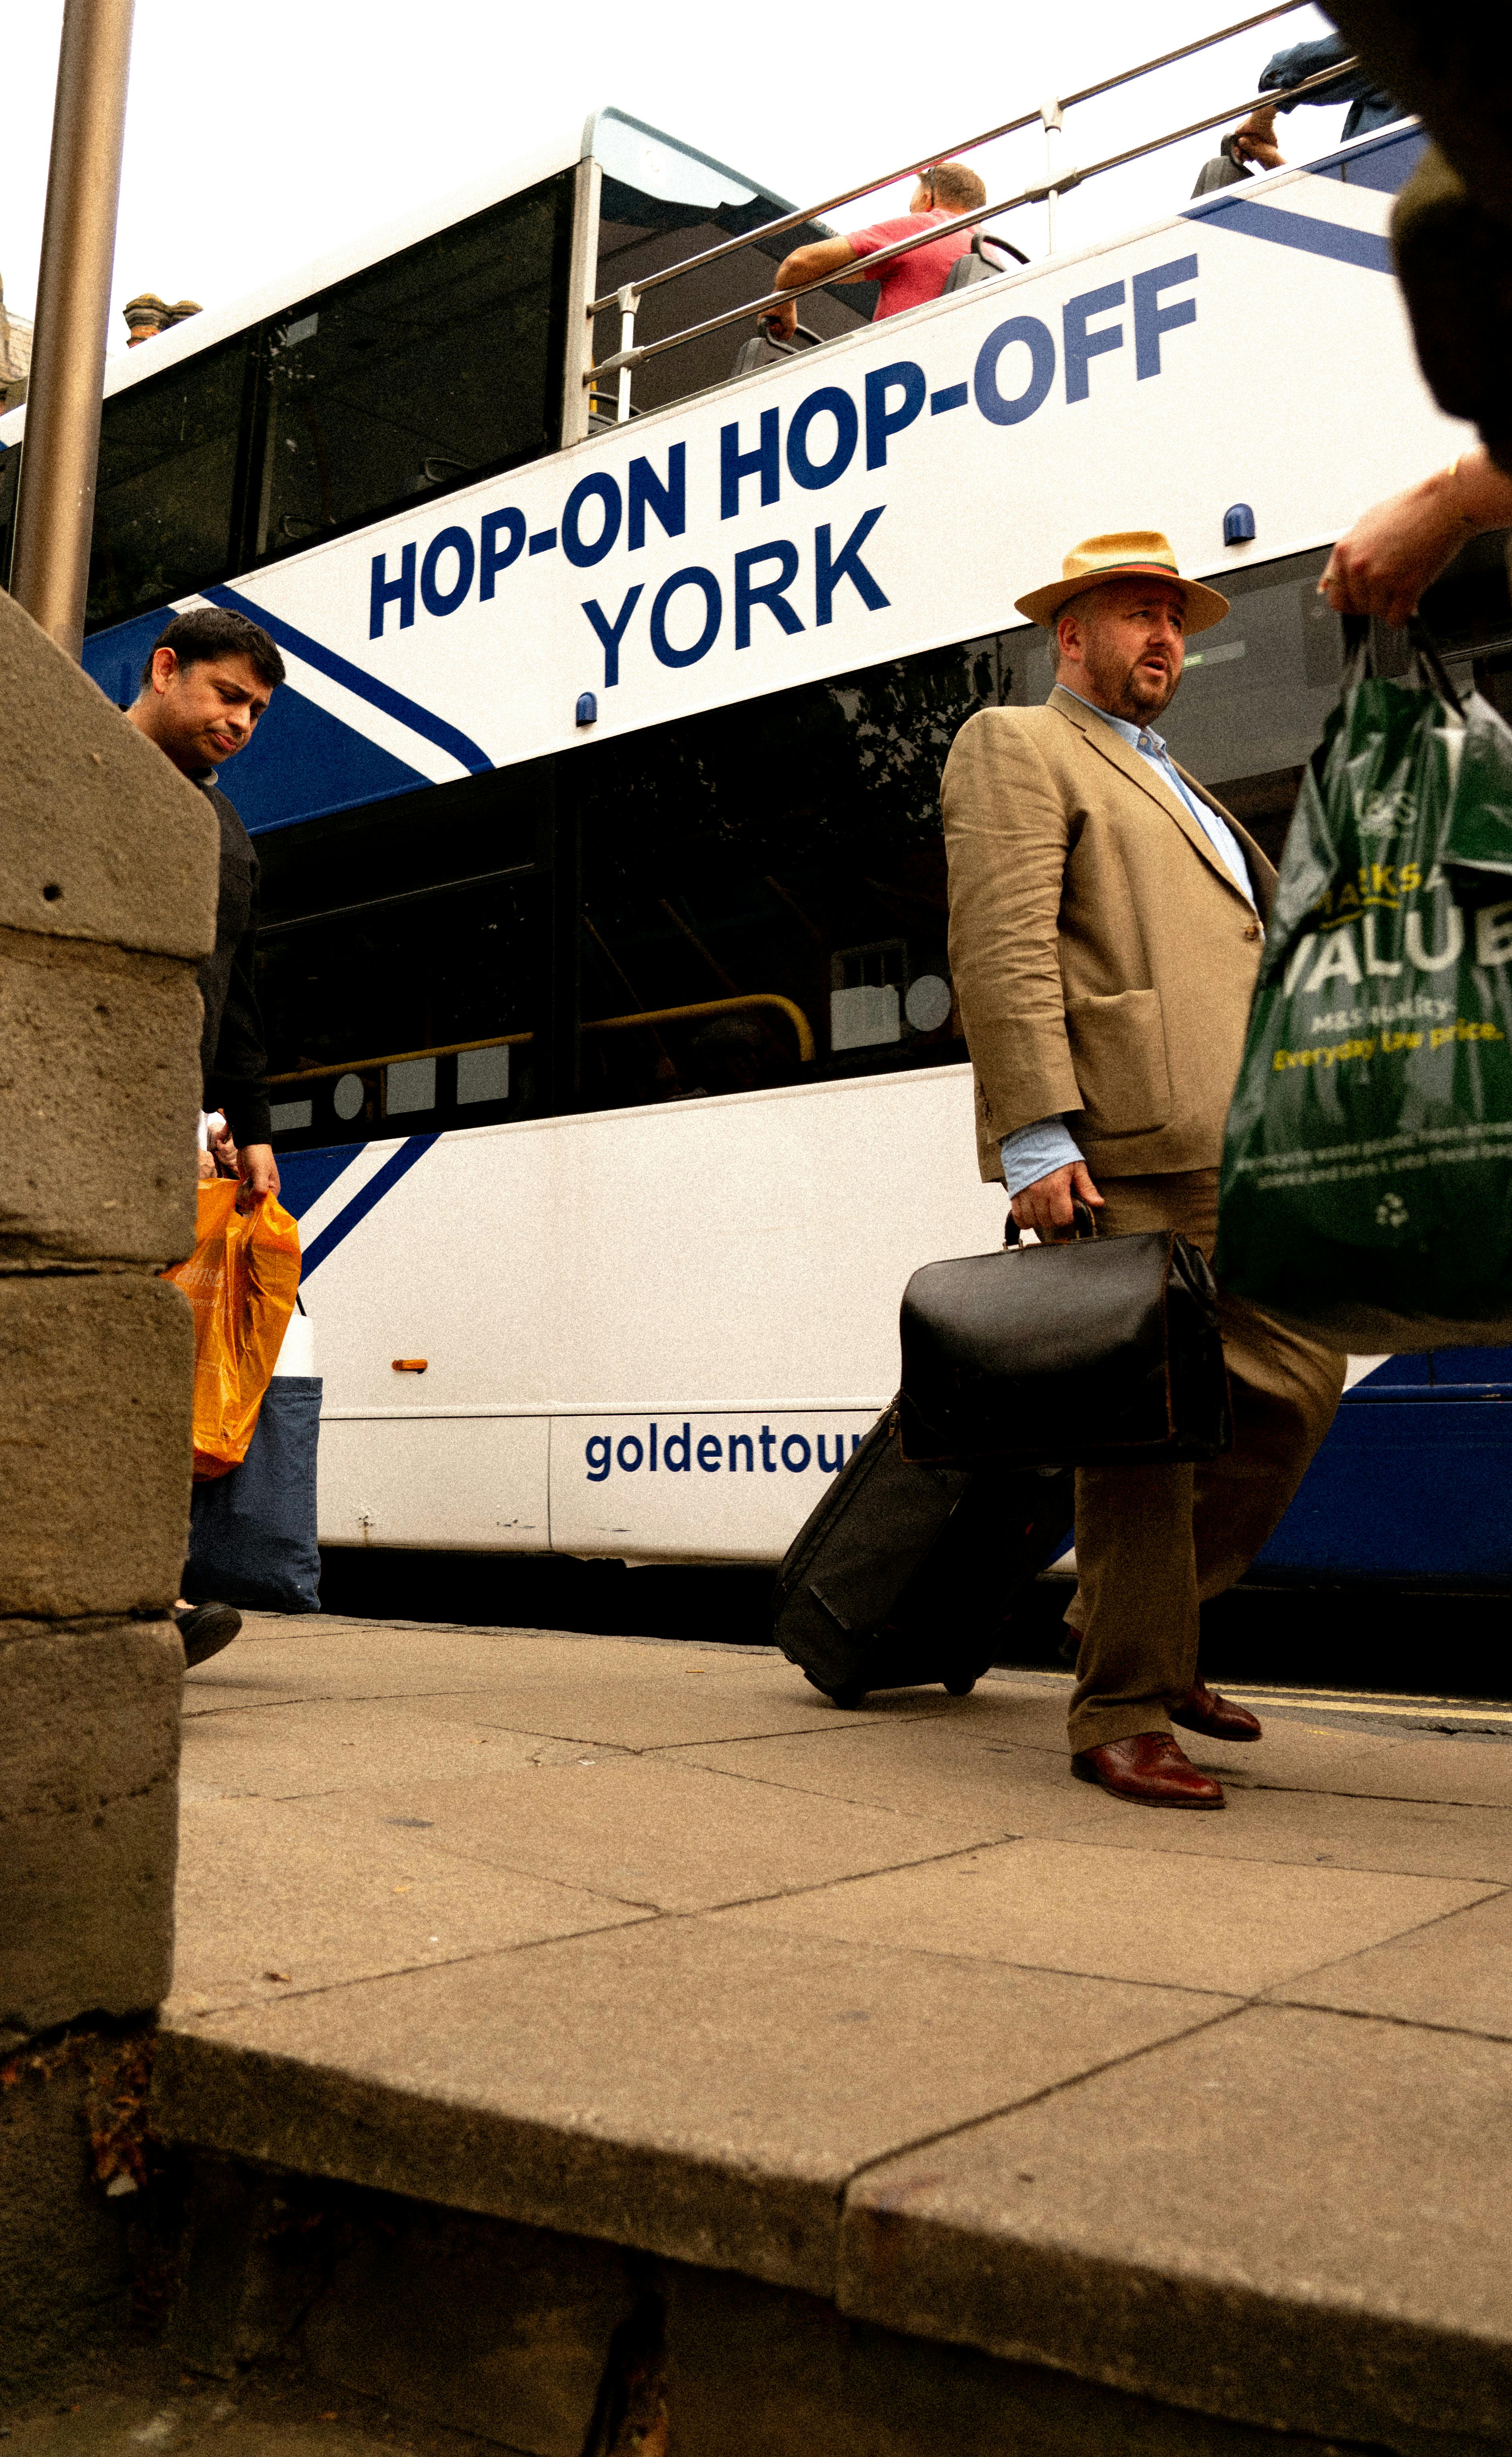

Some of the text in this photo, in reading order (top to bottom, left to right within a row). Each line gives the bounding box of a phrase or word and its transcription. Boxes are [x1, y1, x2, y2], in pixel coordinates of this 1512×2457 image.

[369, 254, 1198, 640] HOP-ON HOP-OFF
[581, 505, 891, 688] YORK
[1272, 1018, 1505, 1072] Everyday low price.
